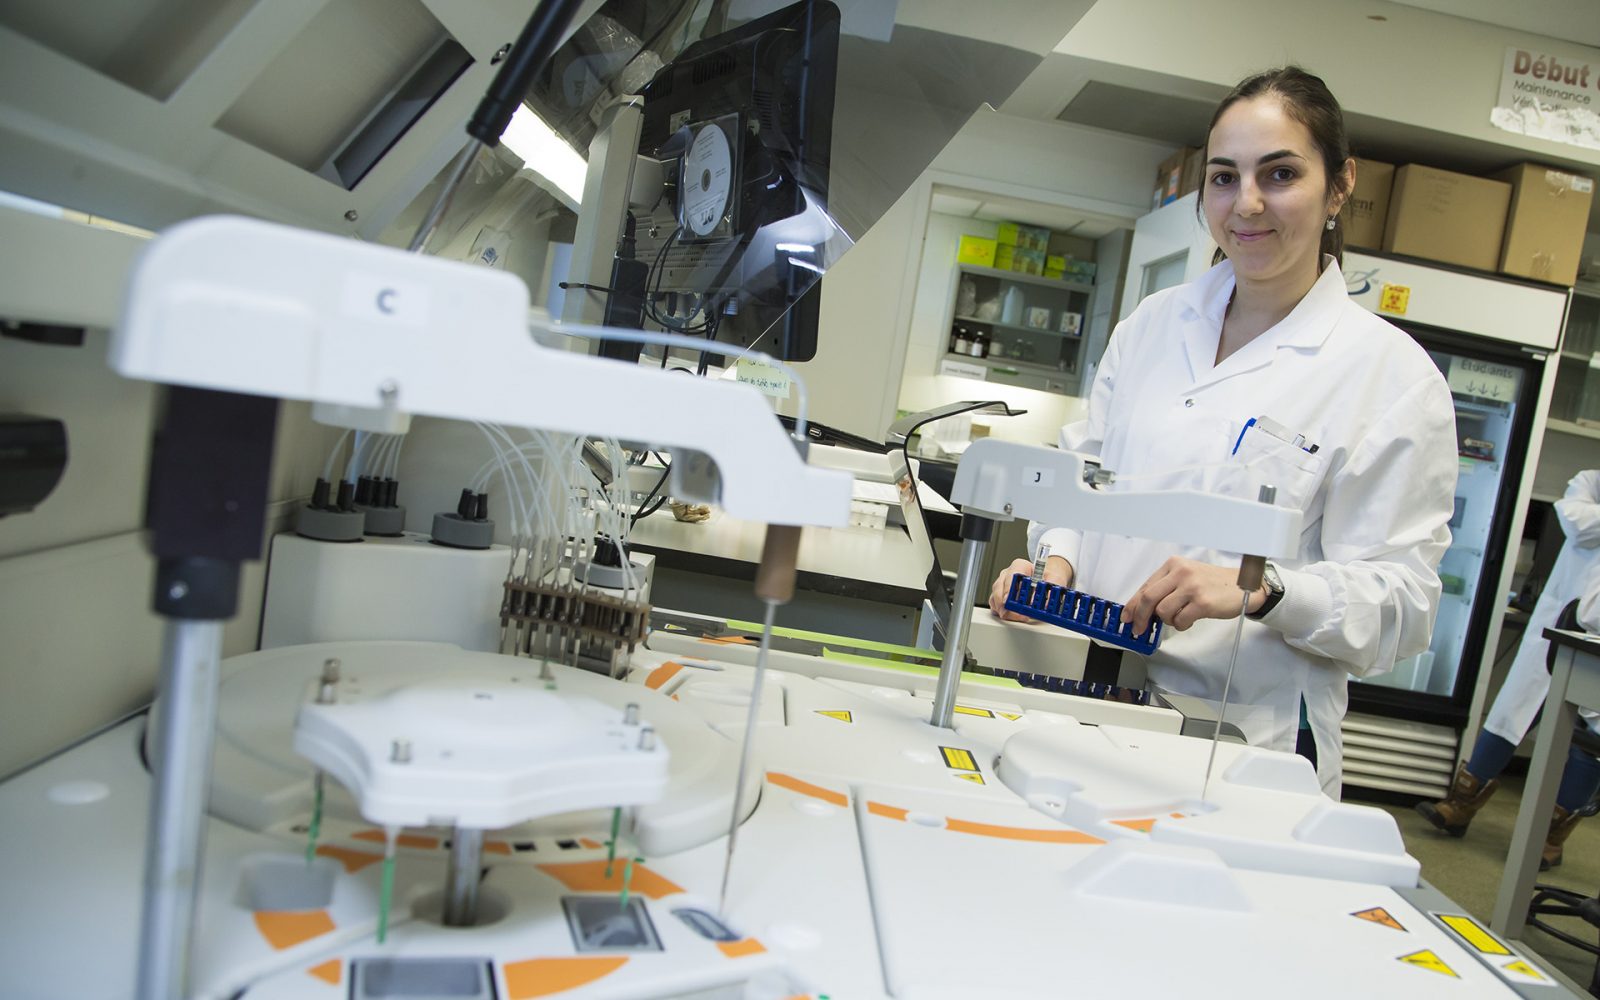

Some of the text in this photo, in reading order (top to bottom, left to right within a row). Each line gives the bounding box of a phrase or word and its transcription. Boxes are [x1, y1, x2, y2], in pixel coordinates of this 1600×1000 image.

[1513, 50, 1590, 88] Début
[1513, 80, 1591, 105] Maintenance
[376, 287, 399, 316] C
[1034, 471, 1042, 483] J
